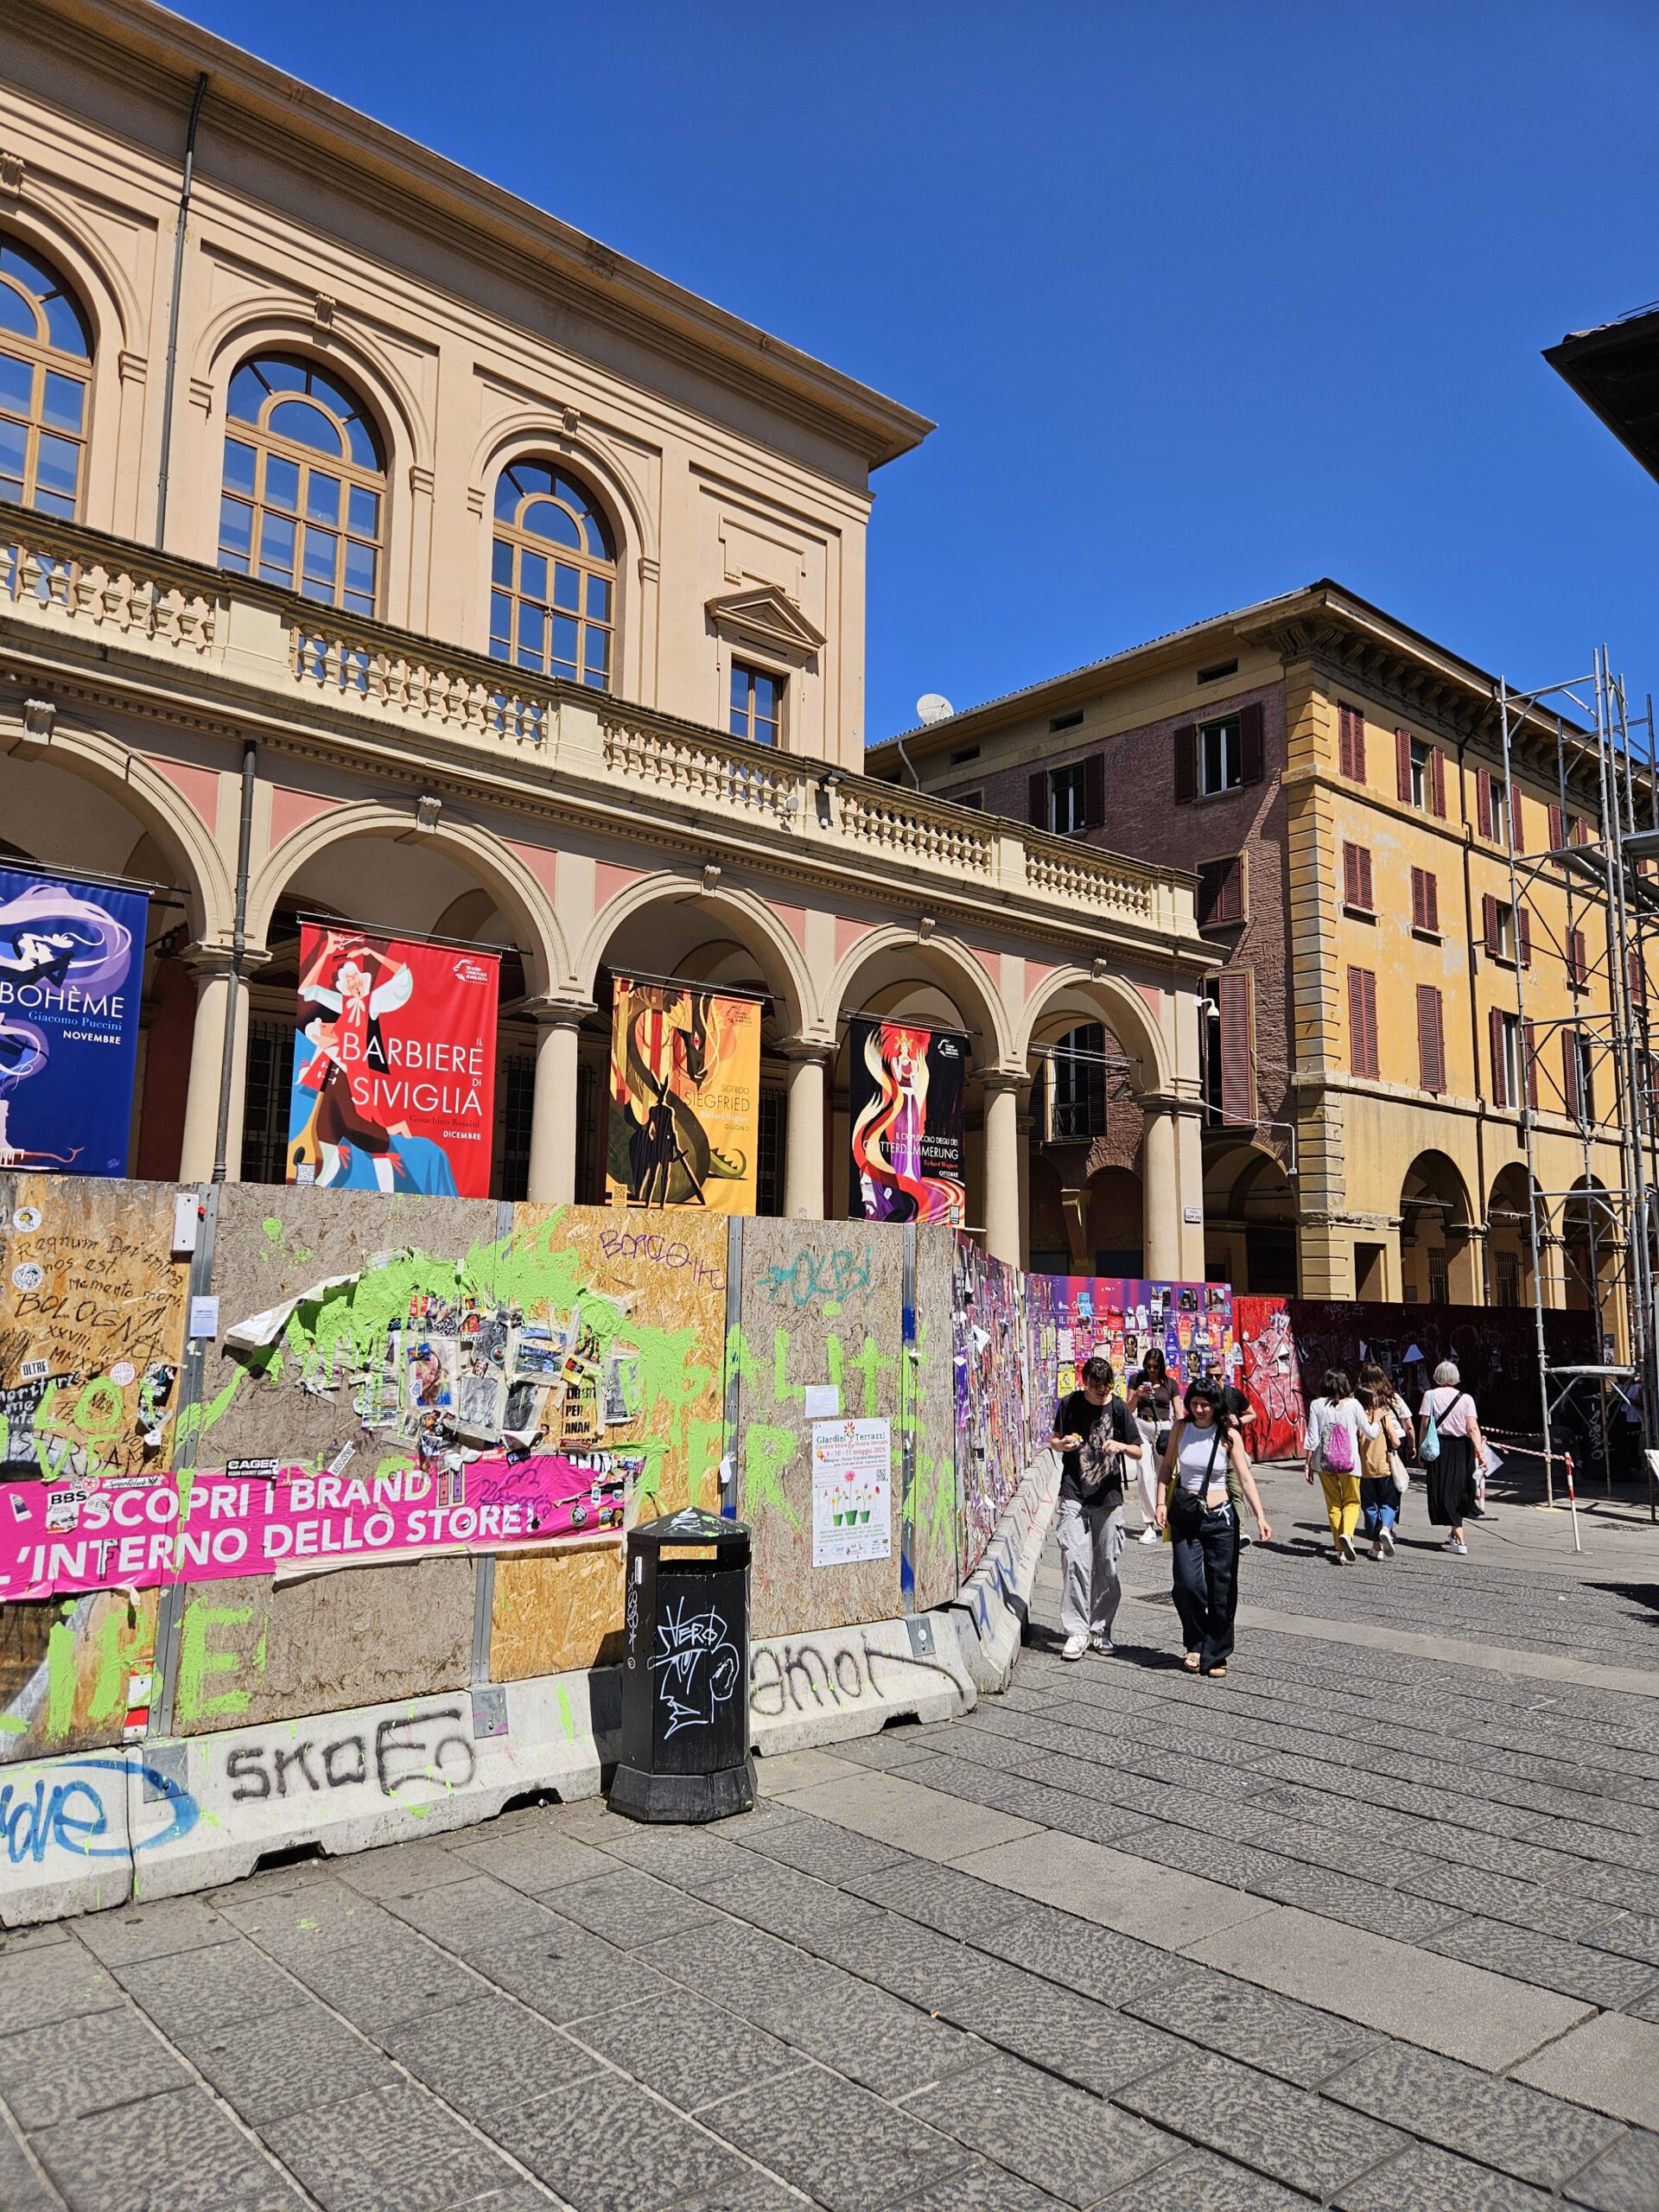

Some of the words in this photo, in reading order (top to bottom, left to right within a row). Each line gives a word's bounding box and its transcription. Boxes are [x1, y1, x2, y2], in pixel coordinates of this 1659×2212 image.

[0, 981, 125, 1019] BOHÈME
[29, 1010, 79, 1026] Giacomo
[81, 1017, 123, 1031] Puccini
[63, 1030, 122, 1045] NOVEMBRE
[476, 1037, 483, 1046] IL
[342, 1032, 484, 1076] BARBIERE
[472, 1077, 482, 1087] DI
[351, 1077, 483, 1116] SIVIGLIA
[684, 1091, 750, 1112] SIEGFRIED
[452, 1118, 480, 1128] Rossini
[724, 1123, 750, 1132] GIUGNO
[443, 1130, 481, 1141] DICEMBRE
[22, 1360, 47, 1376] OLTRE
[817, 1434, 846, 1444] Giardini
[855, 1431, 886, 1441] Terrazzi
[227, 1459, 278, 1470] CAGED
[51, 1491, 86, 1504] BBS
[83, 1483, 250, 1529] SCOPRI
[289, 1468, 431, 1513] BRAND
[94, 1501, 110, 1510] ESN
[0, 1527, 248, 1586] 'INTERNO
[263, 1509, 395, 1559] DELLO
[405, 1503, 537, 1543] STORE!
